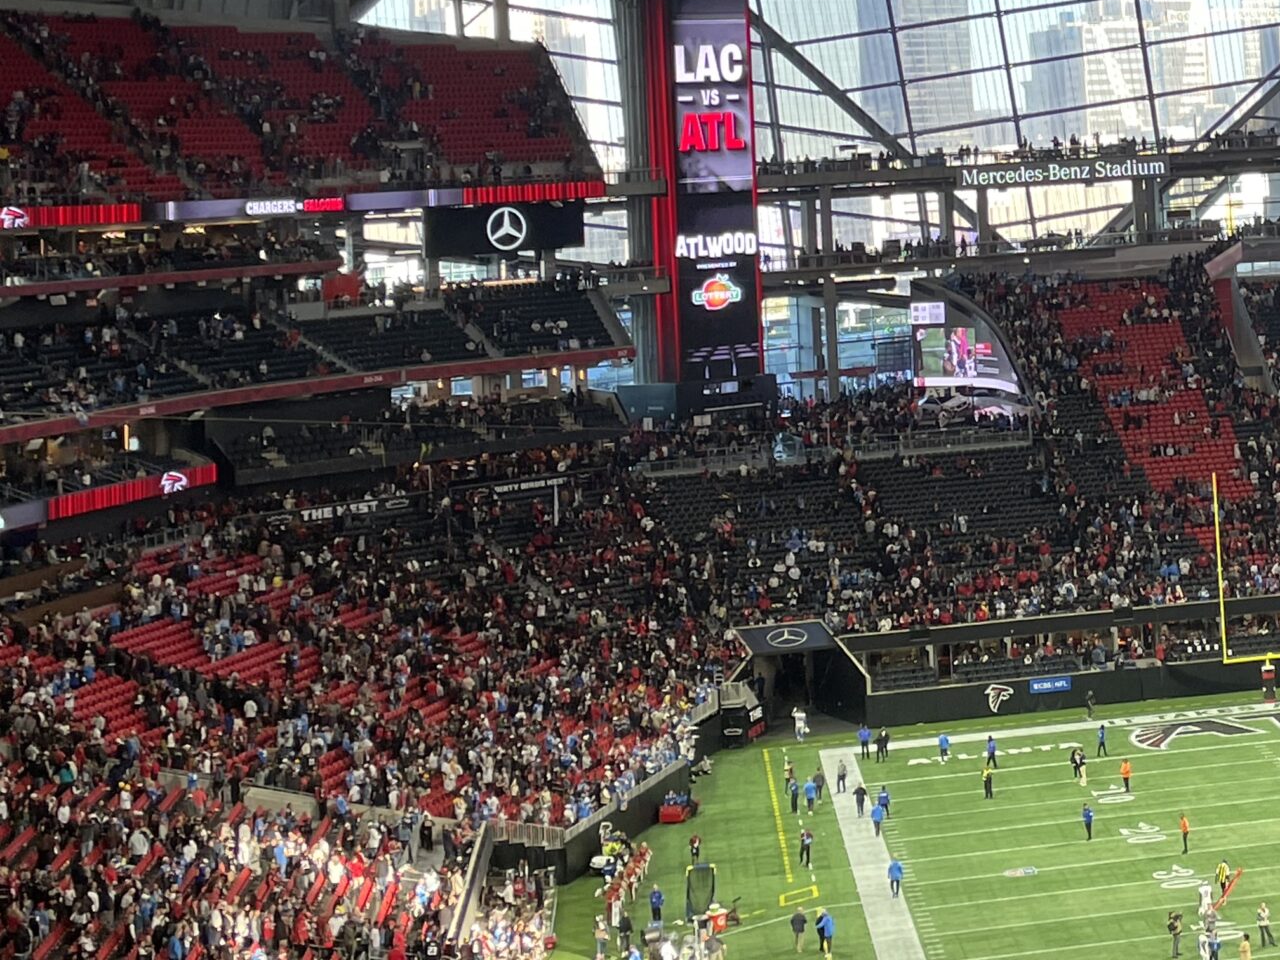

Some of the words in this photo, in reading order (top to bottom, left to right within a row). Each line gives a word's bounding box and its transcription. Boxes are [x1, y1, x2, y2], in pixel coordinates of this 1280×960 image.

[674, 43, 744, 84] LAC
[701, 90, 720, 107] VS
[678, 112, 746, 153] ATL
[962, 163, 1091, 186] Mercedes-Benz
[1095, 159, 1165, 178] Stadium
[245, 200, 296, 215] CHARGERS
[303, 197, 345, 212] FALCONS
[675, 231, 757, 259] ATLWOOD
[694, 288, 740, 303] LOTTERY
[301, 507, 333, 521] THE
